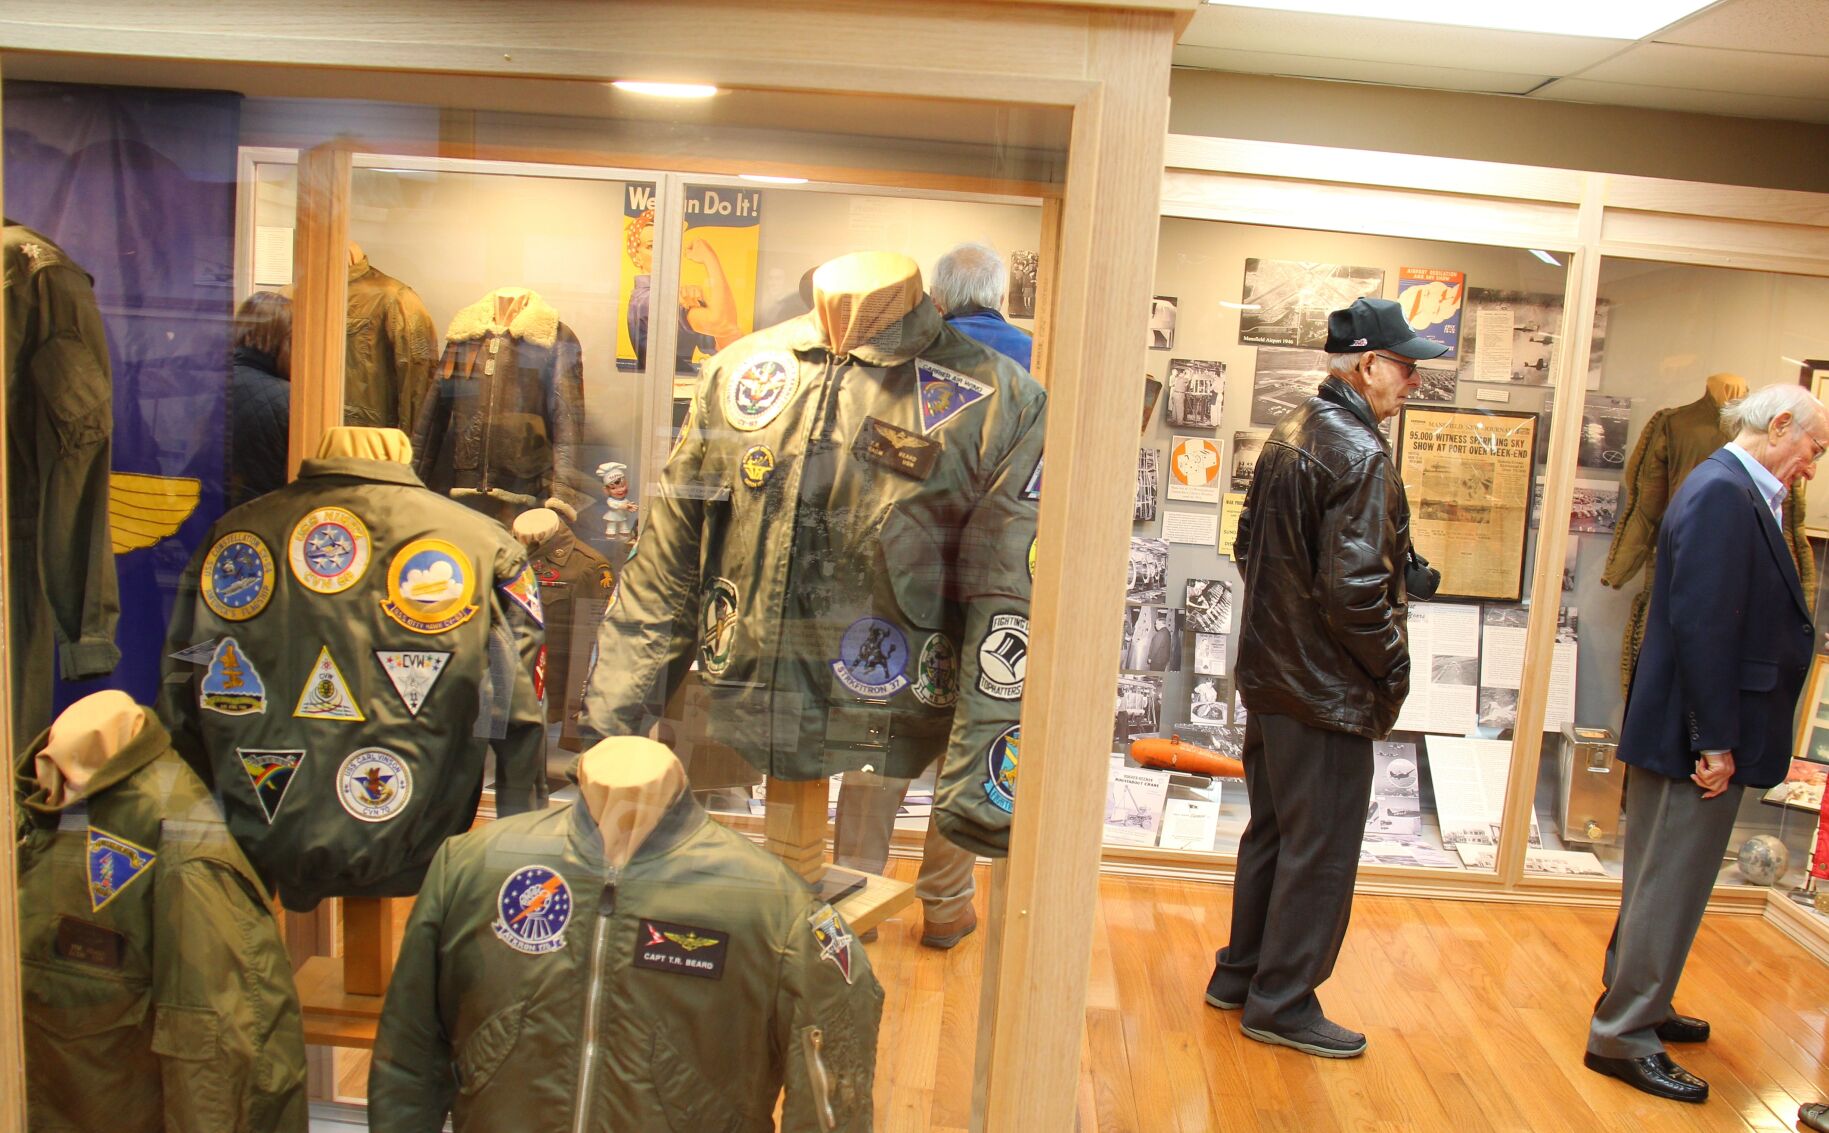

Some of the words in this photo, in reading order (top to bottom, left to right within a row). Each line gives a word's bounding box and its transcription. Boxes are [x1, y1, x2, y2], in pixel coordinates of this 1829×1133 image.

[628, 186, 656, 210] We
[704, 191, 732, 216] Do
[736, 192, 760, 217] It!
[922, 364, 951, 379] CARRIER
[952, 375, 963, 383] AIR
[1436, 434, 1467, 444] WITNESS
[1470, 436, 1508, 448] SPARKING
[1510, 439, 1525, 448] SKY
[1413, 442, 1434, 452] SHOW
[1436, 444, 1446, 452] AT
[1469, 446, 1488, 456] OVER
[993, 616, 1025, 628] FIGHTING
[403, 654, 424, 668] CVW
[890, 680, 900, 690] 37
[981, 676, 1022, 696] TOPHATTERS
[345, 762, 357, 777] USS
[357, 754, 377, 764] CARL
[378, 755, 401, 774] VINSON
[362, 807, 380, 815] CVN
[381, 806, 391, 814] 70
[643, 952, 666, 963] CAPT
[668, 956, 682, 966] T.R.
[685, 958, 714, 970] BEARD
